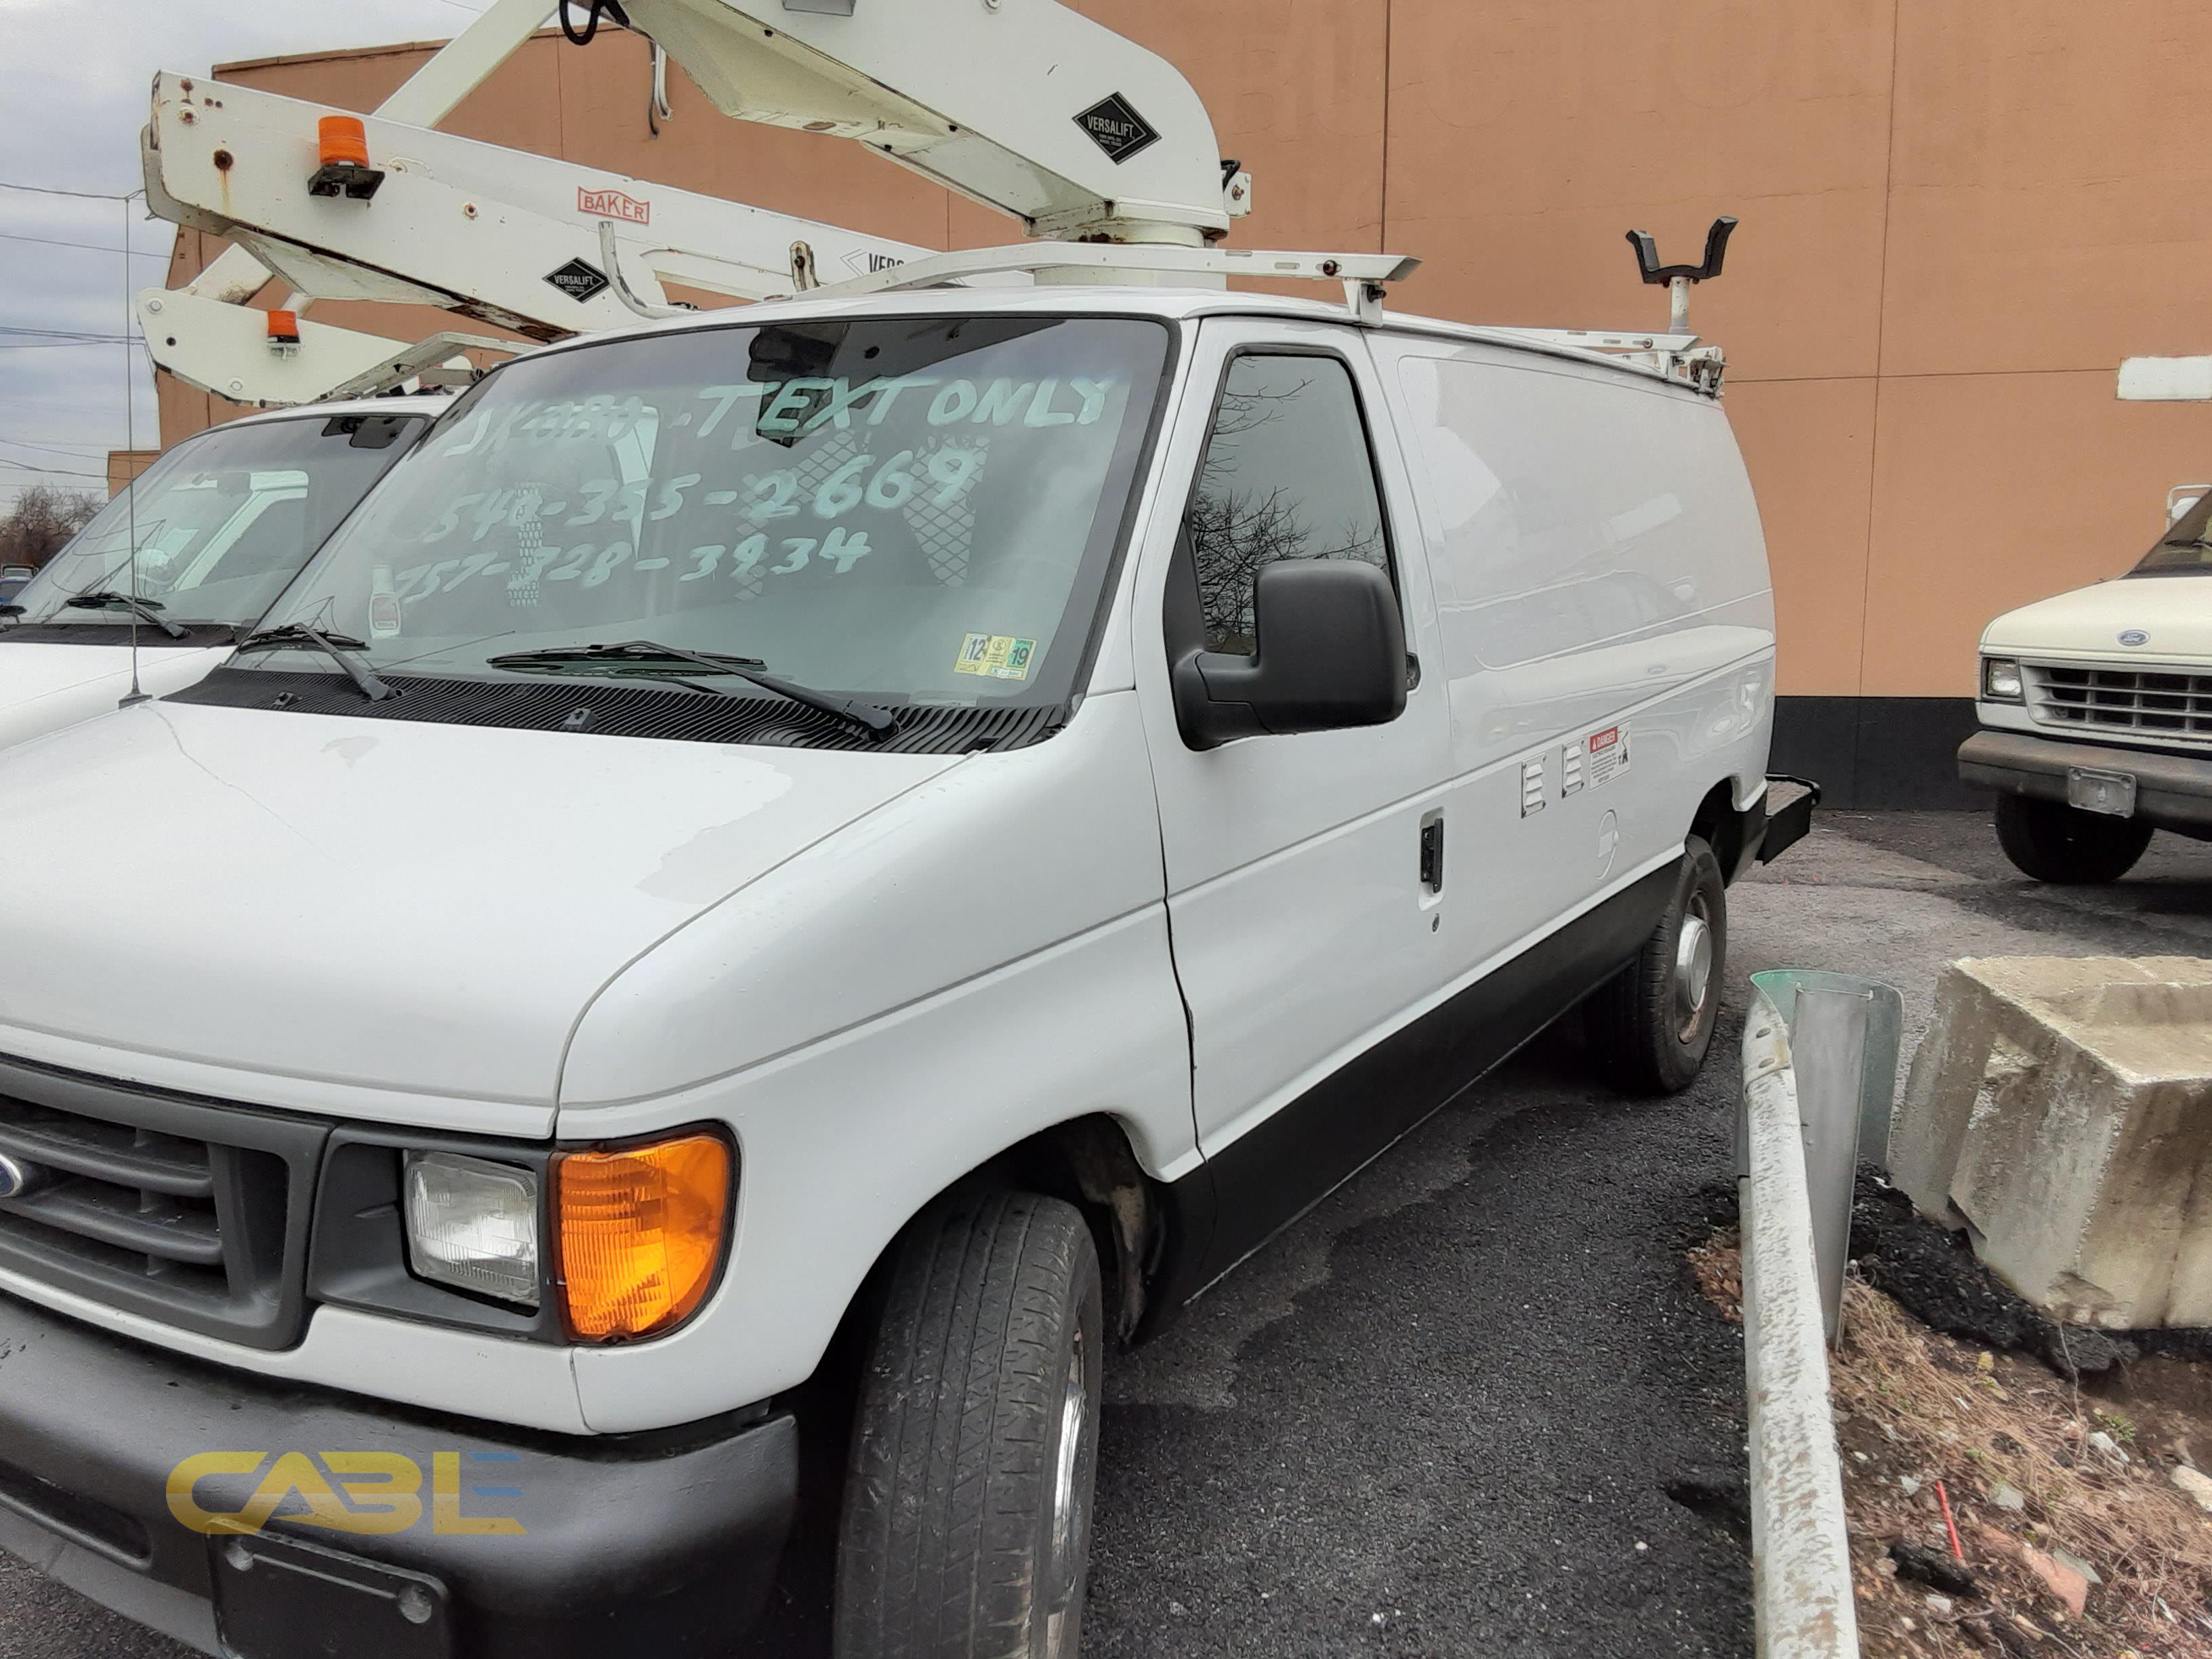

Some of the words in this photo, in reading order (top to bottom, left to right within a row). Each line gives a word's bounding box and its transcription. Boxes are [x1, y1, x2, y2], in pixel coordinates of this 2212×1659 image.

[1086, 115, 1134, 138] VERSALIFT
[584, 195, 644, 220] BAKER
[869, 253, 905, 272] VE
[554, 274, 595, 286] VERSALIFT
[926, 375, 1115, 428] ONLY
[968, 638, 986, 661] 12
[1012, 647, 1029, 665] 19
